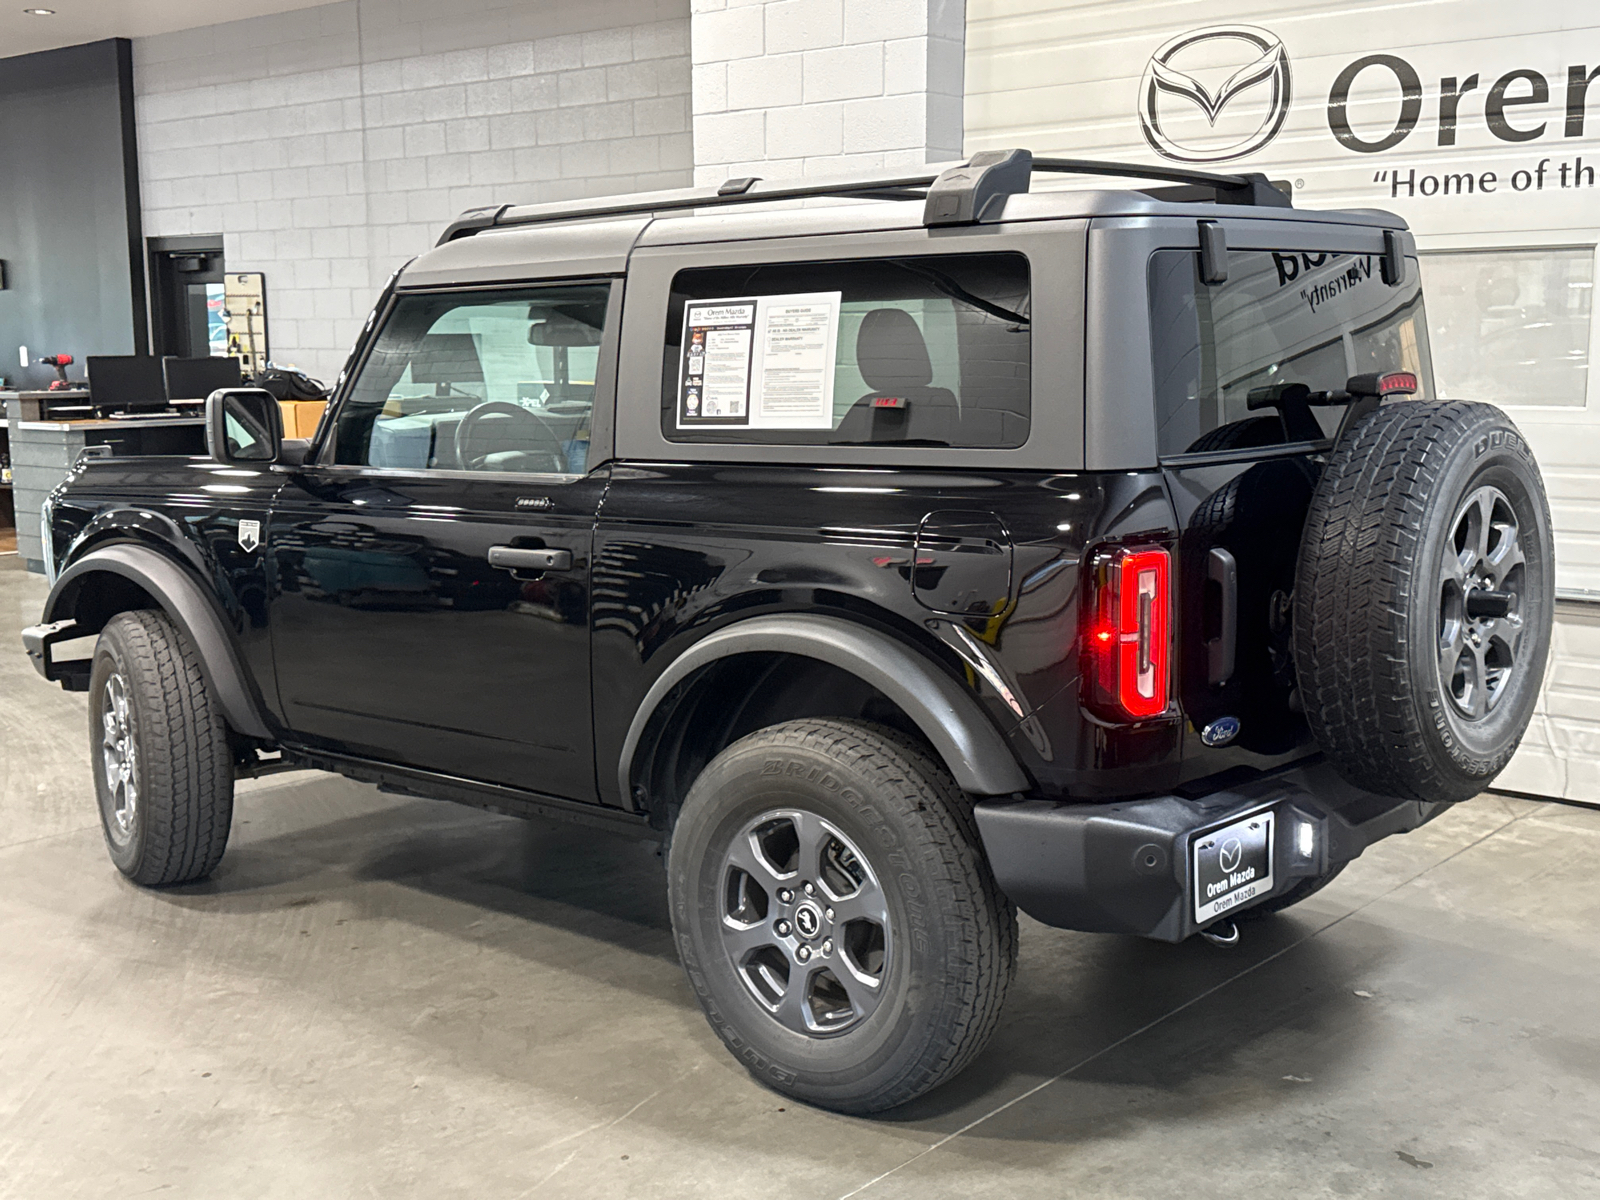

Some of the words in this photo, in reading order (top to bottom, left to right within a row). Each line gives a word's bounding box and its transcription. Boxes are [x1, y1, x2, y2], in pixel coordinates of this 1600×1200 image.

[1511, 158, 1550, 191] of
[759, 757, 933, 952] BRIDGESTONE
[1206, 878, 1229, 898] Orem
[1229, 866, 1256, 888] Mazda
[1213, 897, 1233, 913] Orem
[1233, 886, 1256, 903] Mazda
